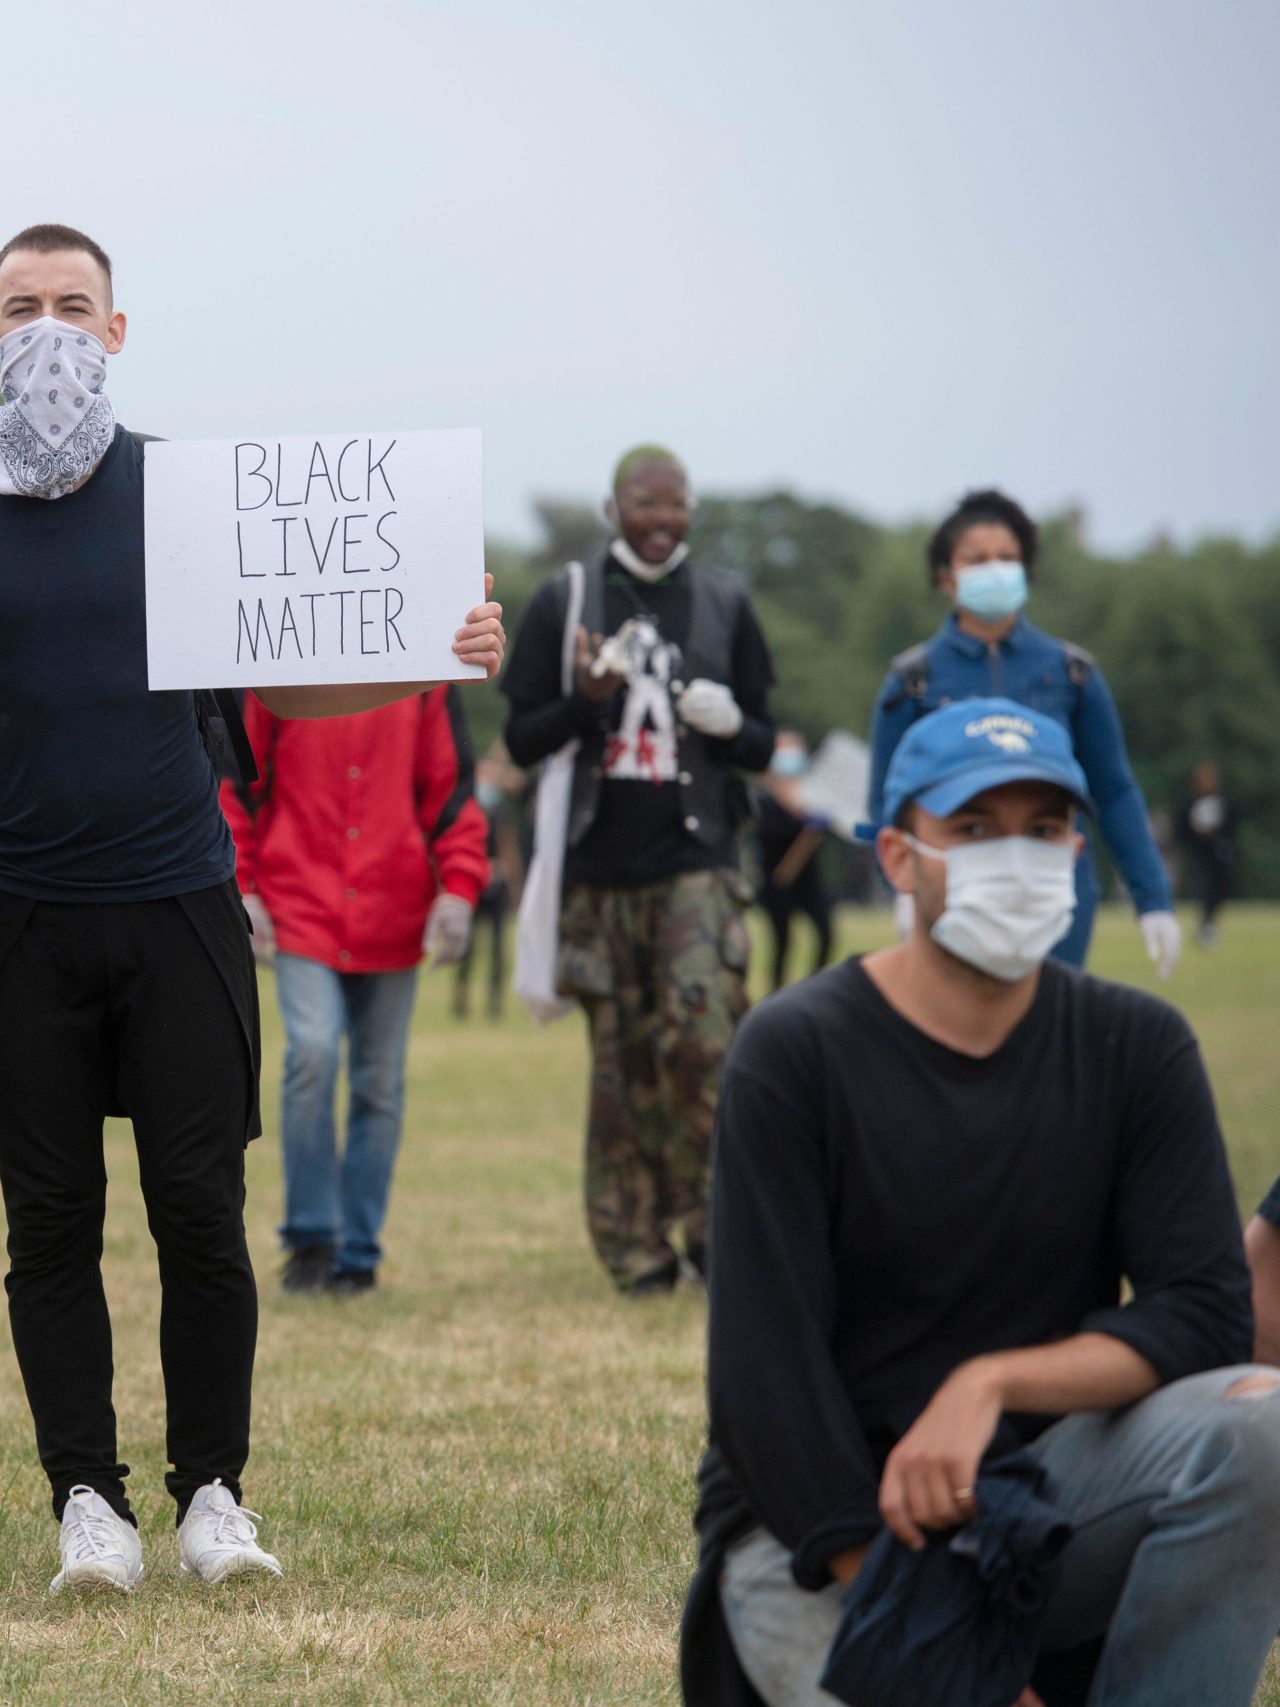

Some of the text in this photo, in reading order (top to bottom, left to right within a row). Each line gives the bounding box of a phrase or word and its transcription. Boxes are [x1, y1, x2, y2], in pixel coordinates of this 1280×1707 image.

[235, 438, 397, 511] BLACK
[237, 510, 401, 578] LIVES
[236, 587, 407, 664] MATTER
